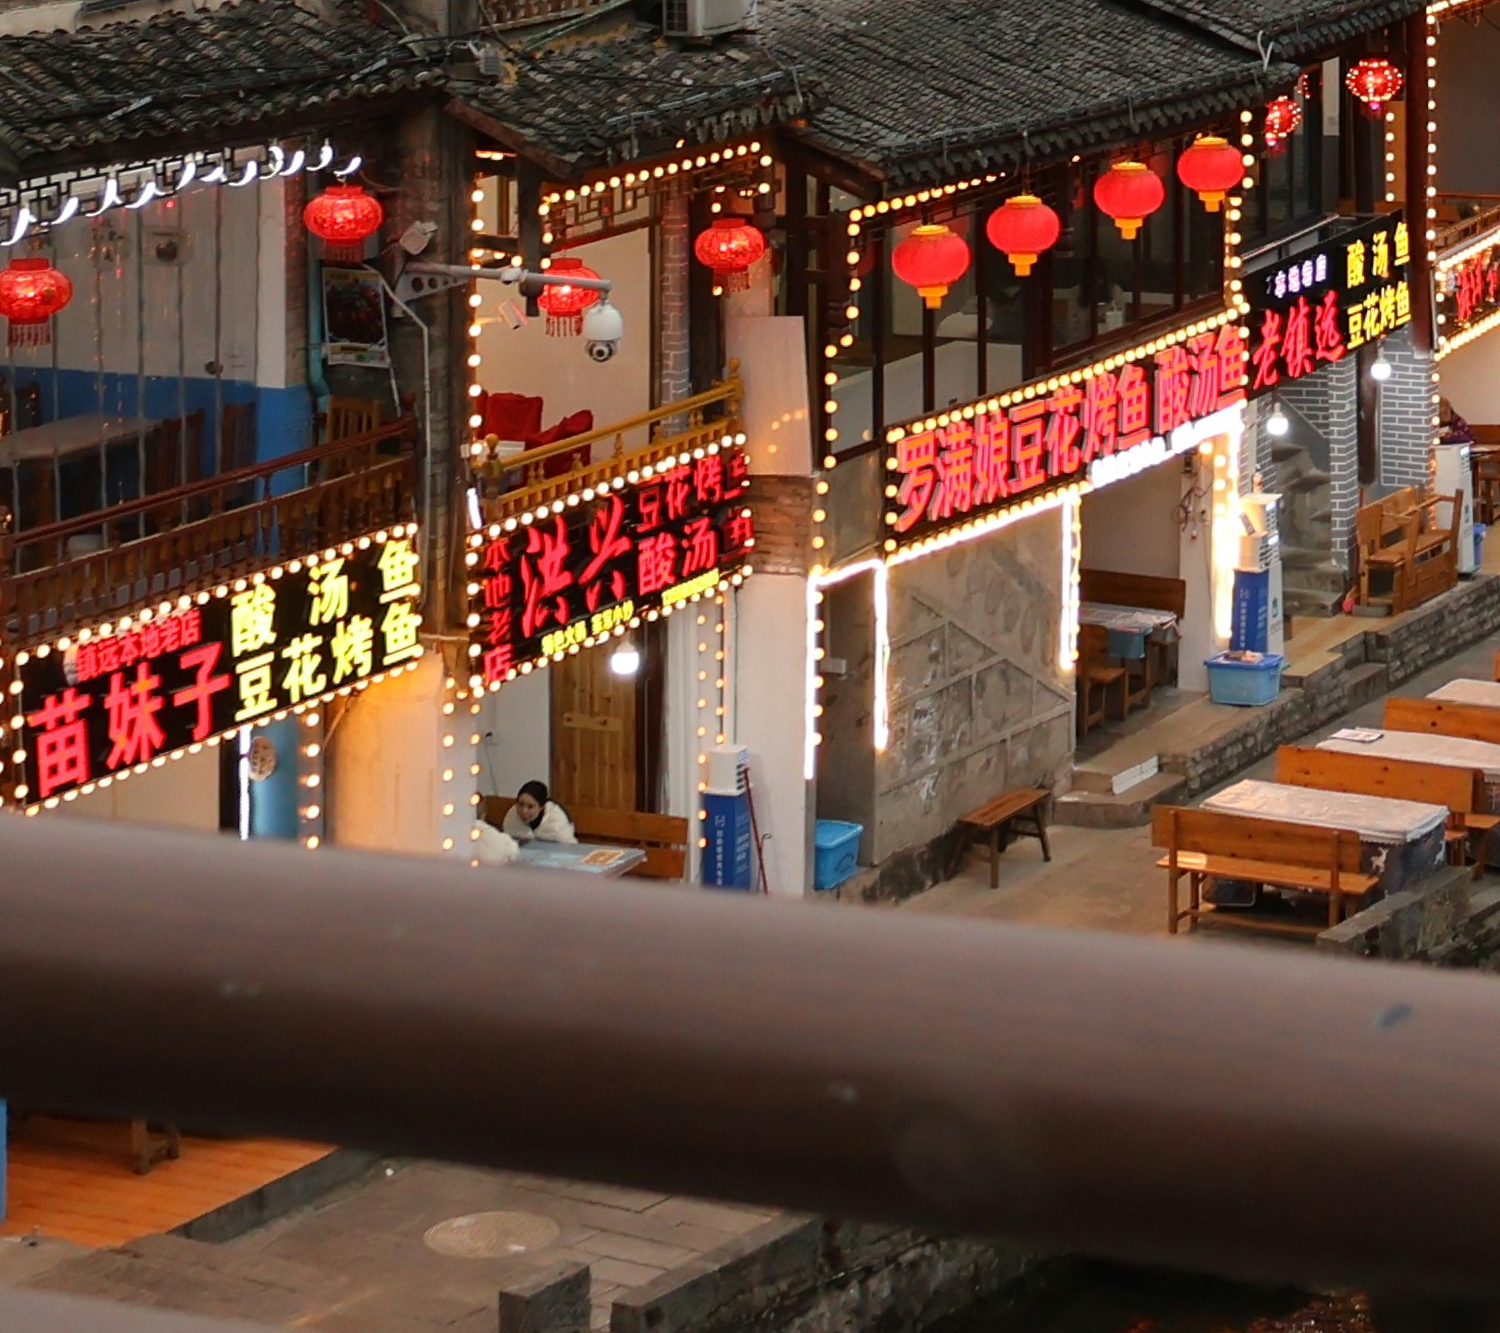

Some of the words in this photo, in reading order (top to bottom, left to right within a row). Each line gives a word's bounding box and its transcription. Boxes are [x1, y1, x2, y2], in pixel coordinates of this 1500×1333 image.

[1347, 221, 1410, 289] 酸汤鱼
[1252, 290, 1347, 390] 老镇远
[1347, 280, 1412, 350] 豆花烤鱼
[231, 539, 419, 658] 酸汤鱼
[484, 537, 514, 684] 本地老店
[520, 493, 633, 638] 洪兴
[75, 609, 201, 683] 镇远本地老店
[234, 603, 421, 723] 豆花烤鱼
[29, 641, 231, 798] 苗妹子
